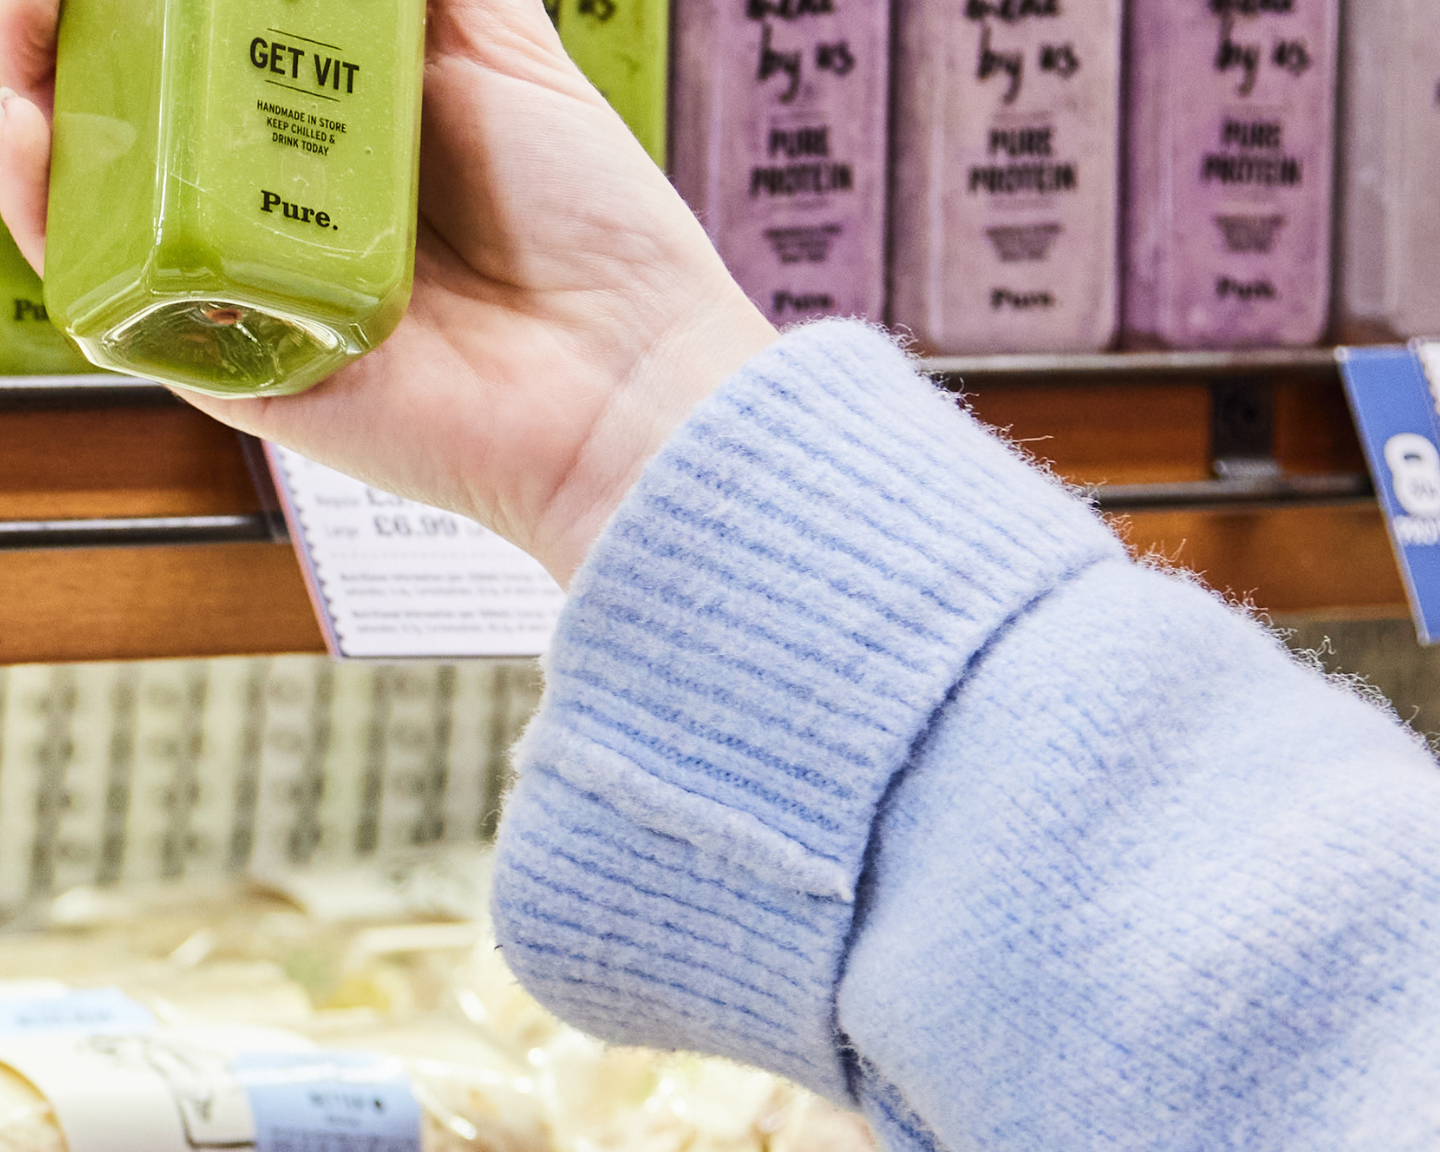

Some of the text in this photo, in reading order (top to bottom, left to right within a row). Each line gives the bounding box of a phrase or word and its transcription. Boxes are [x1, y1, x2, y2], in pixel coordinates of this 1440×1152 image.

[250, 37, 360, 94] GET VIT
[976, 24, 1023, 105] by
[257, 99, 347, 133] HANDMADE IN STORE
[266, 116, 335, 144] KEEP CHILLED &
[272, 132, 329, 156] DRINK TODAY
[261, 189, 339, 231] Pure.
